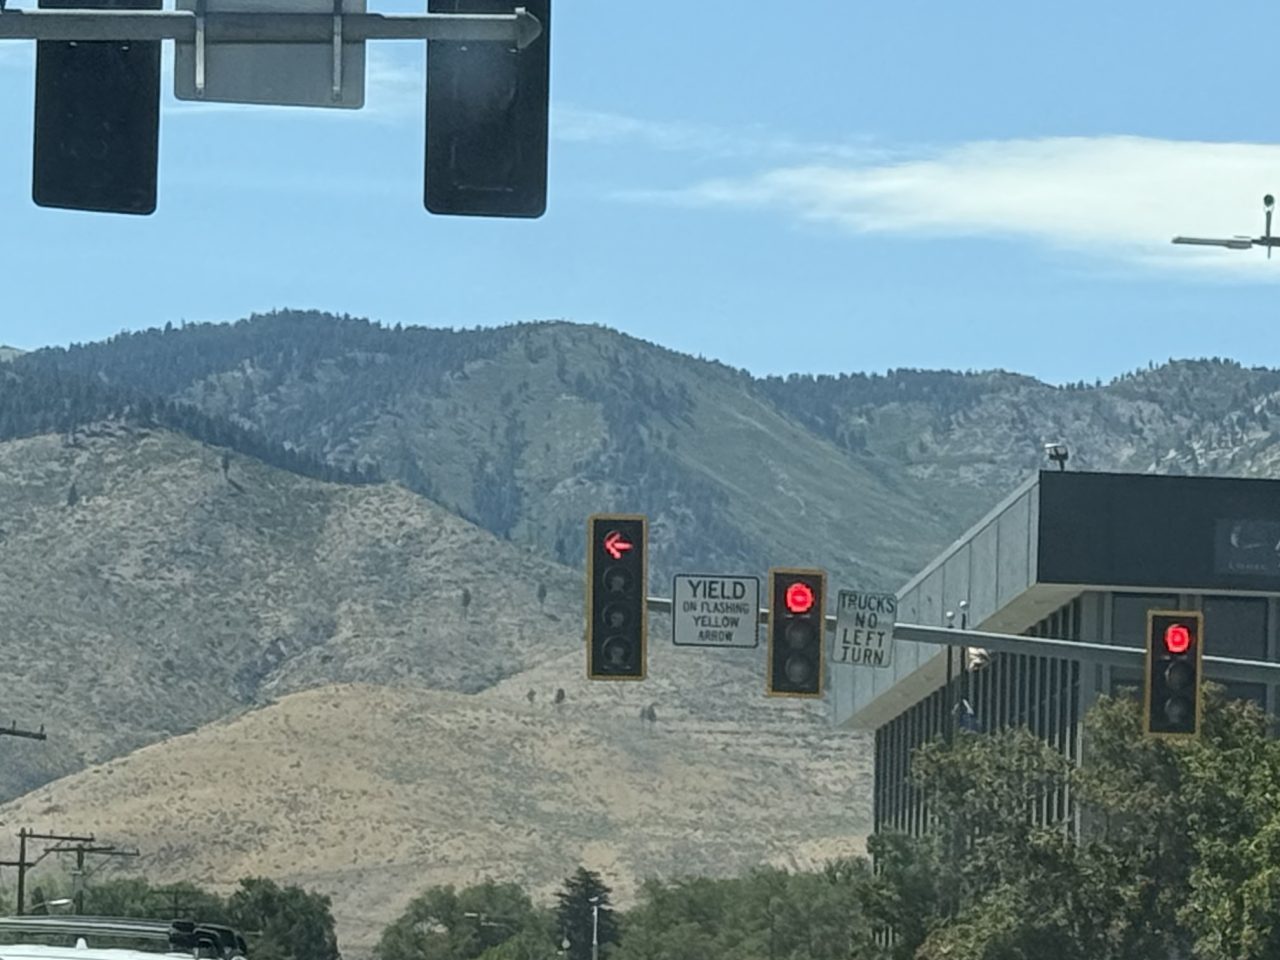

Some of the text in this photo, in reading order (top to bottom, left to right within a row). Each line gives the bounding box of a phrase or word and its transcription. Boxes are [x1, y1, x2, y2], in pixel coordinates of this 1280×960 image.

[688, 579, 746, 599] YIELD
[683, 601, 697, 612] ON
[840, 593, 894, 613] TRUCKS
[693, 616, 740, 628] YELLOW
[855, 611, 878, 629] NO
[842, 628, 885, 647] LEFT
[841, 646, 884, 665] TURN
